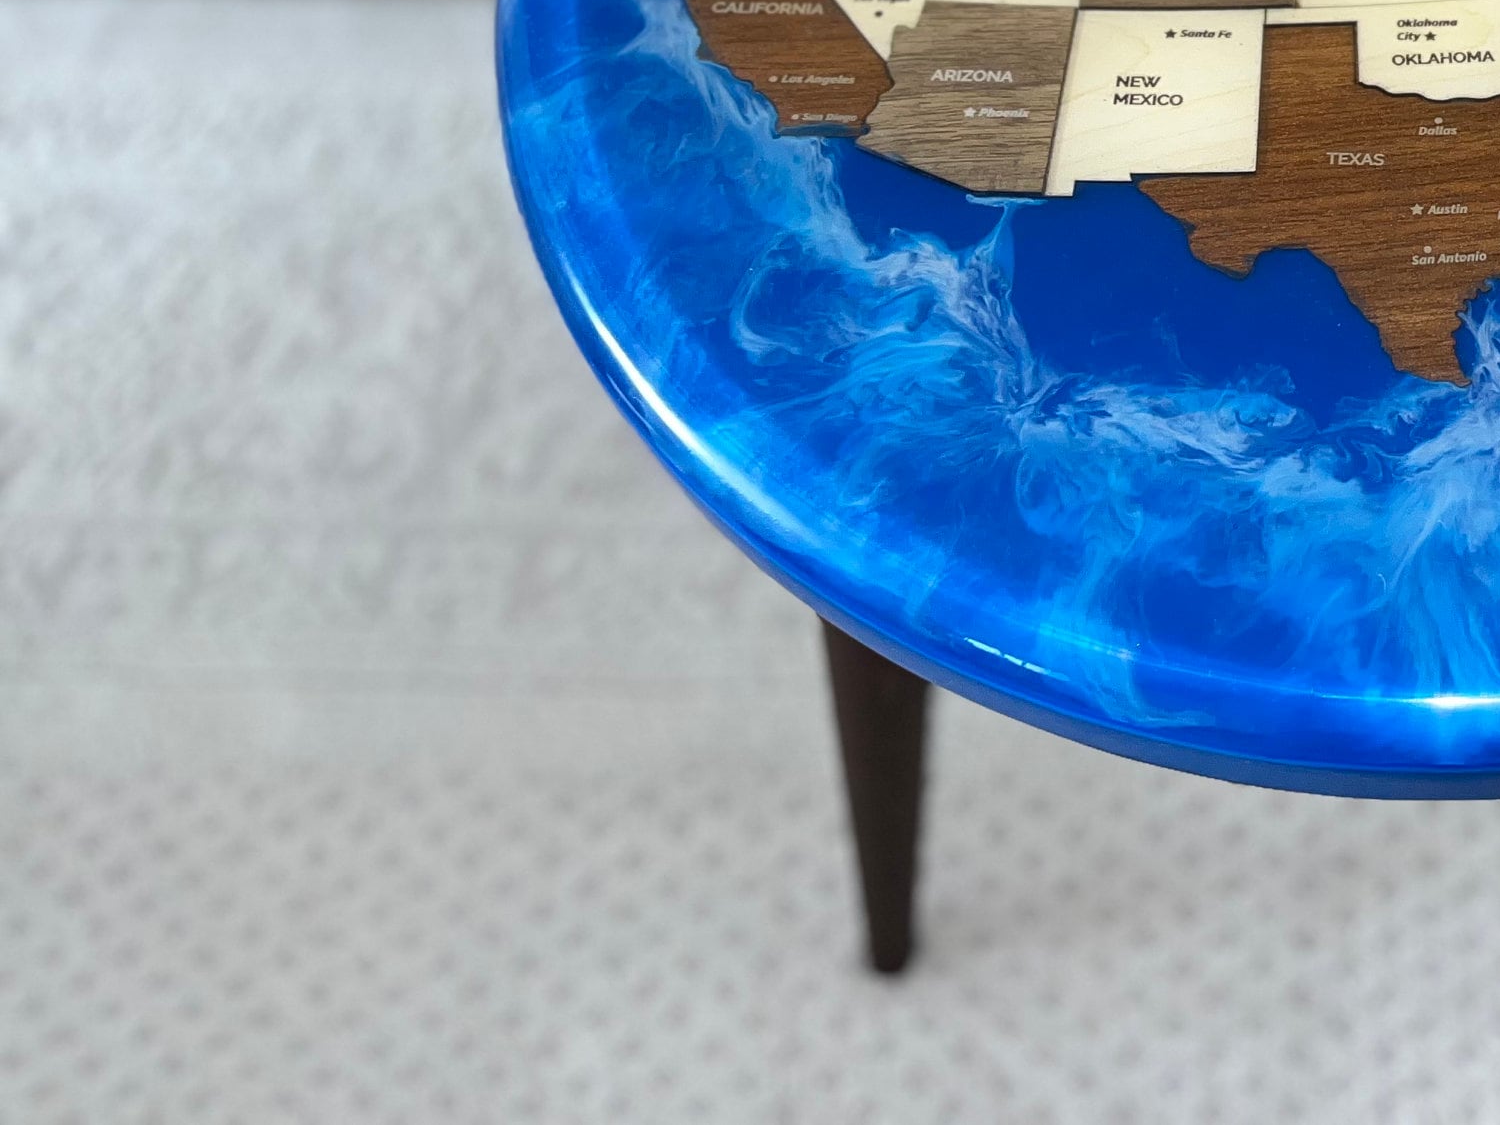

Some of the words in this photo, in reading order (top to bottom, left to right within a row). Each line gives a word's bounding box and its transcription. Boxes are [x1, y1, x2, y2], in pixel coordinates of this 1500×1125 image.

[712, 1, 824, 16] CALIFORNIA
[1397, 18, 1457, 28] Oklahoma
[1180, 29, 1214, 39] Santa
[1218, 29, 1232, 39] Fe
[1397, 32, 1420, 43] City
[1392, 51, 1495, 66] OKLAHOMA
[781, 74, 806, 85] Los
[807, 74, 855, 86] Angeles
[931, 70, 1013, 83] ARIZONA
[1116, 76, 1161, 88] NEW
[1113, 94, 1183, 106] MEXICO
[802, 112, 823, 122] San
[824, 112, 857, 123] Diego
[978, 107, 1030, 119] Phoenix
[1418, 126, 1457, 136] Dallas
[1327, 152, 1385, 166] TEXAS
[1428, 204, 1469, 215] Austin
[1412, 254, 1438, 265] San
[1438, 251, 1487, 265] Antonio
